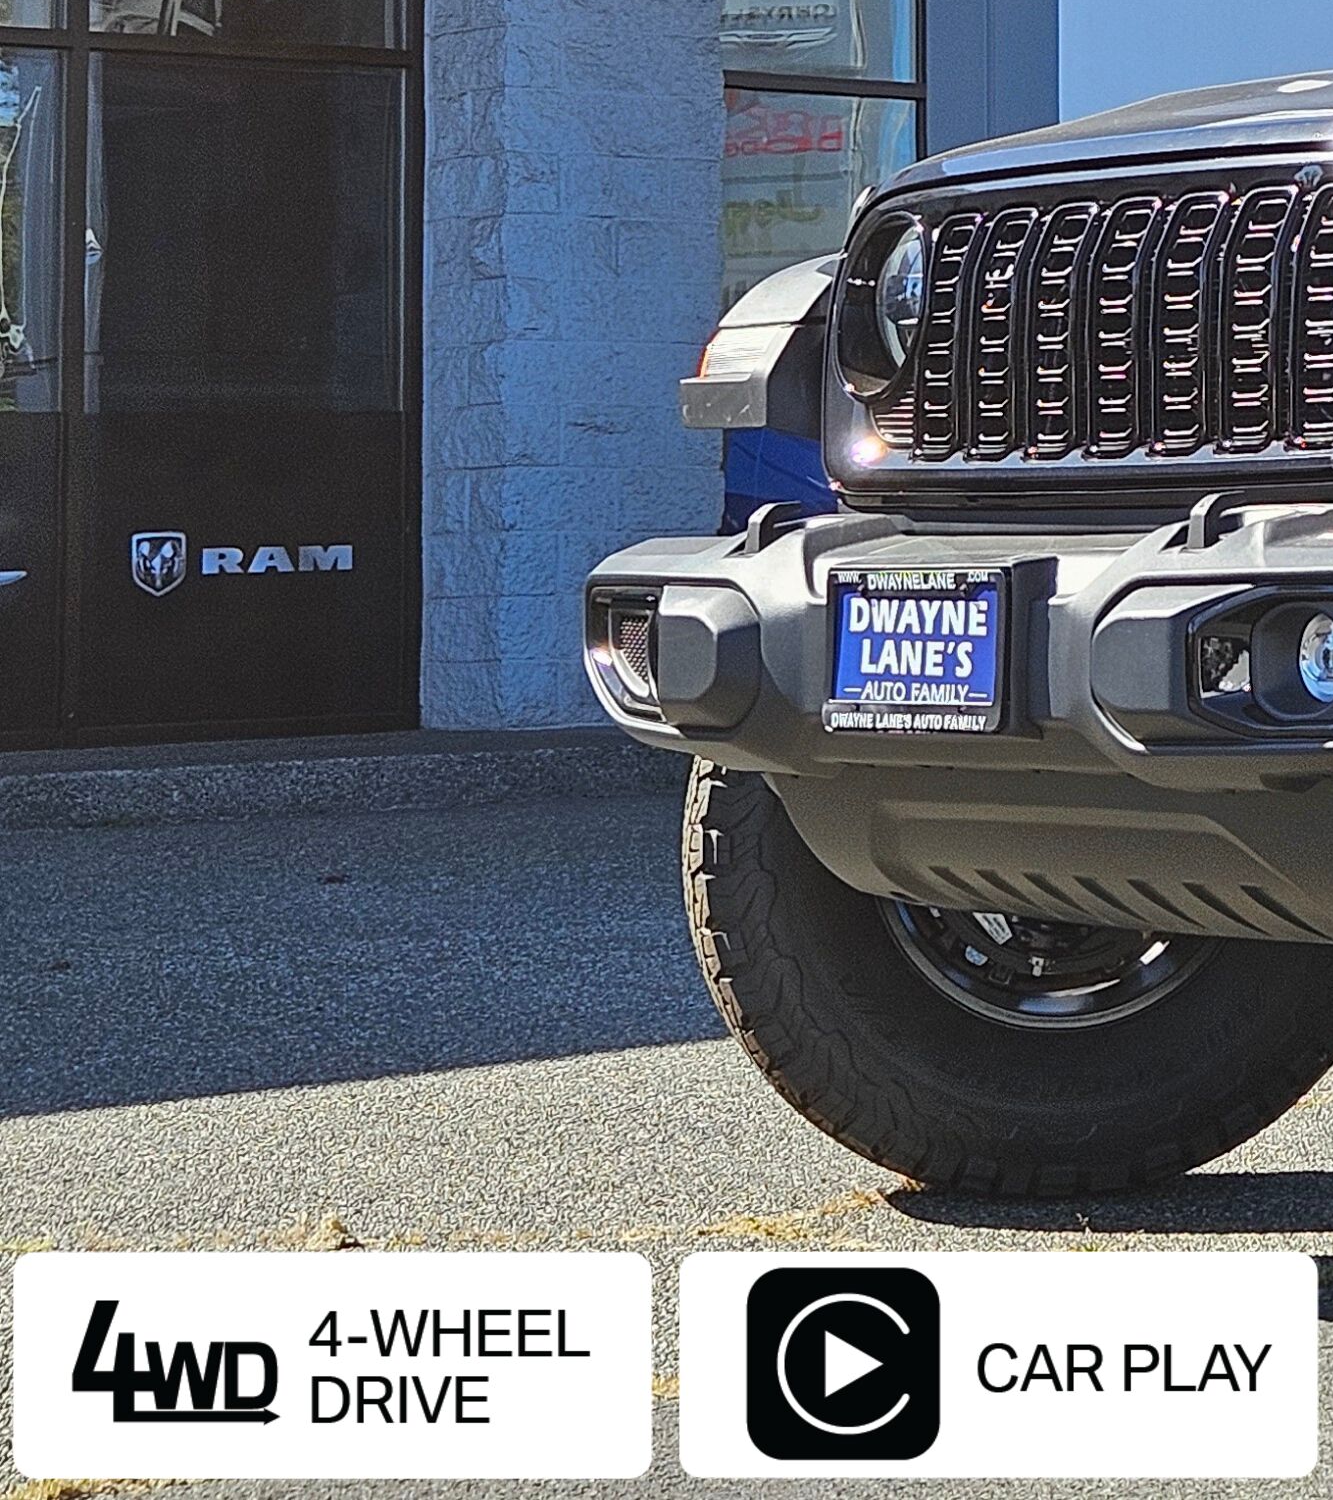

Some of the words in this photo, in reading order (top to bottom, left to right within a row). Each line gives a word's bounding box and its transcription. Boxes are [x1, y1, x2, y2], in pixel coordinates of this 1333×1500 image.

[201, 543, 354, 576] RAM
[867, 571, 957, 591] DWAYNELANE
[848, 596, 989, 637] DWAYNE
[859, 638, 974, 678] LANE'S
[860, 680, 907, 701] AUTO
[910, 682, 970, 703] FAMILY
[830, 712, 874, 729] DWAYNE
[913, 714, 944, 730] AUTO
[943, 715, 987, 732] FAMILY
